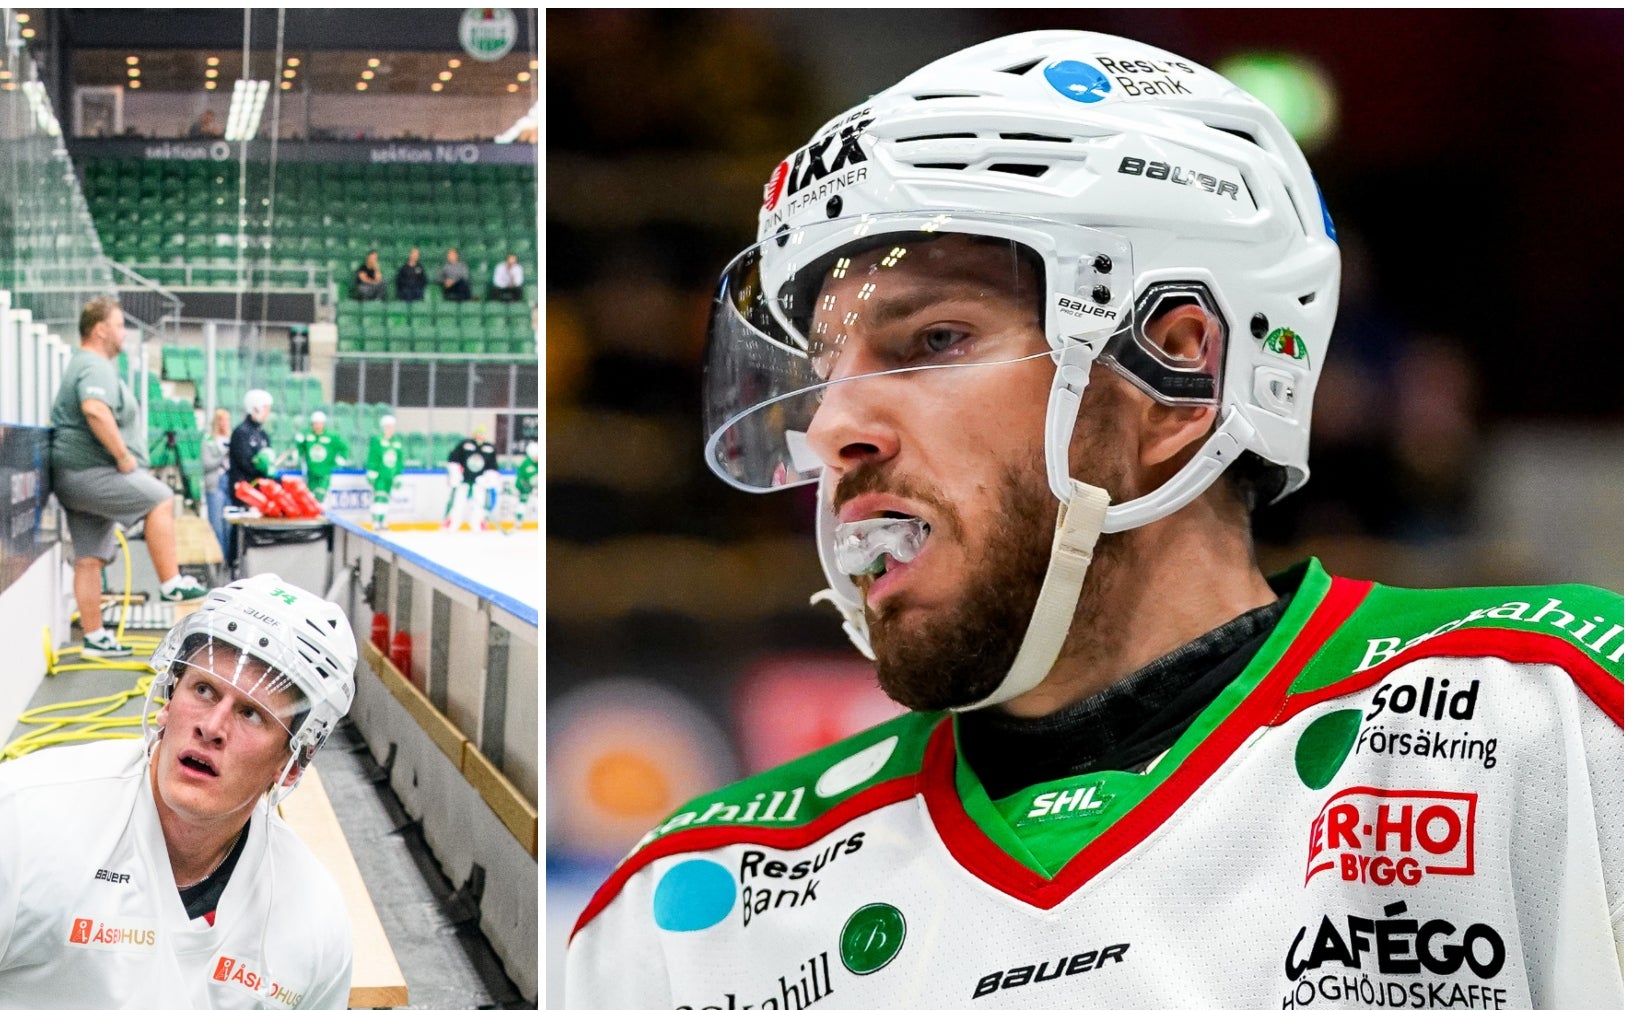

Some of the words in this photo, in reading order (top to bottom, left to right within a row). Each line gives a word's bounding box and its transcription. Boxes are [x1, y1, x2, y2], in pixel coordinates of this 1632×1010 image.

[1115, 75, 1193, 97] Bank
[787, 167, 868, 217] IT-PARTNER
[1027, 786, 1103, 818] SHL
[740, 831, 866, 884] Resurs
[1340, 853, 1423, 887] BYGG
[741, 879, 821, 928] Bank
[1285, 900, 1506, 980] CAFÉGO
